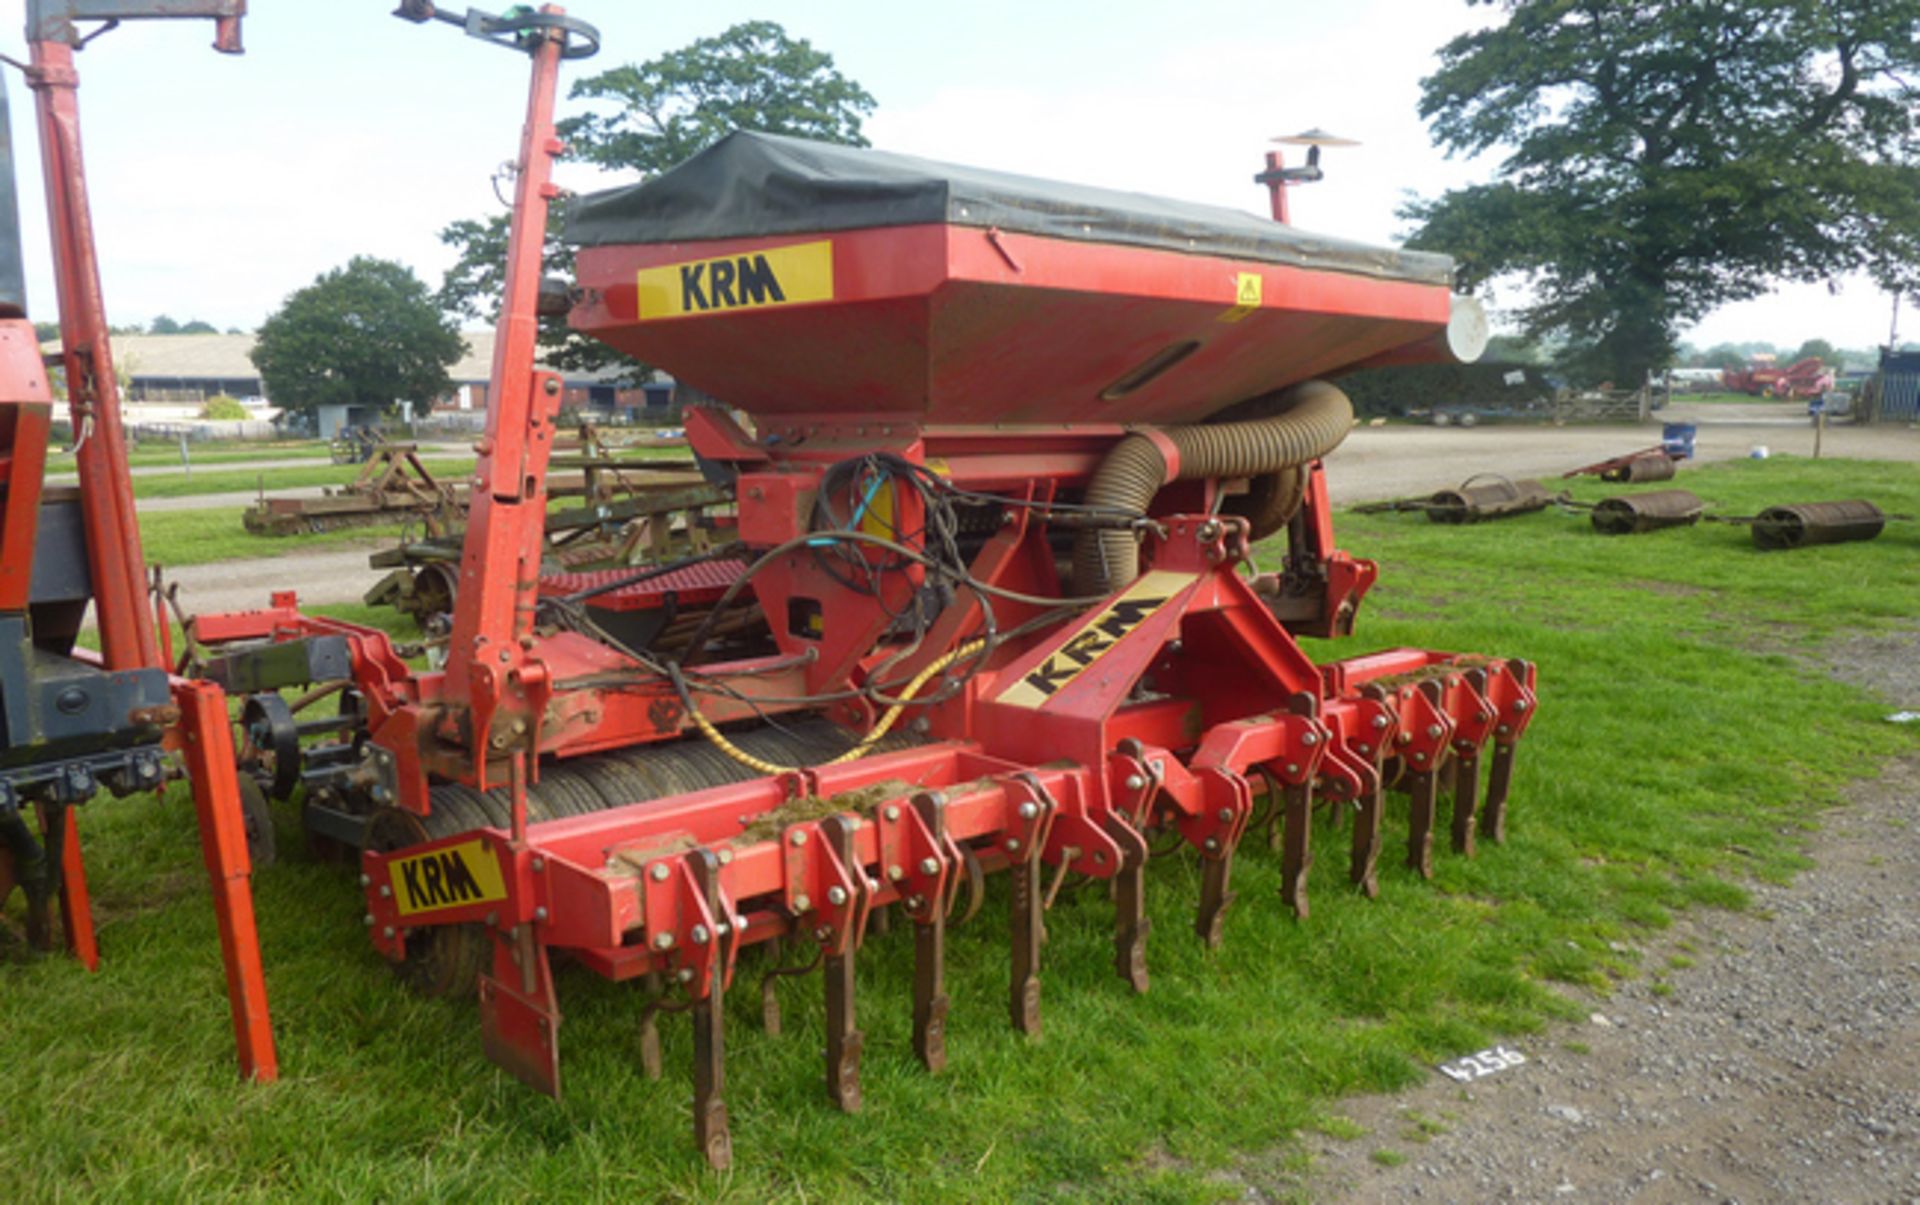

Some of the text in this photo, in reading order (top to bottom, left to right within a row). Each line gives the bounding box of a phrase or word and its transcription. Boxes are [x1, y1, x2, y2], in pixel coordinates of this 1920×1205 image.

[681, 254, 786, 311] KRM
[1025, 597, 1167, 695] KRM
[401, 850, 484, 909] KRM
